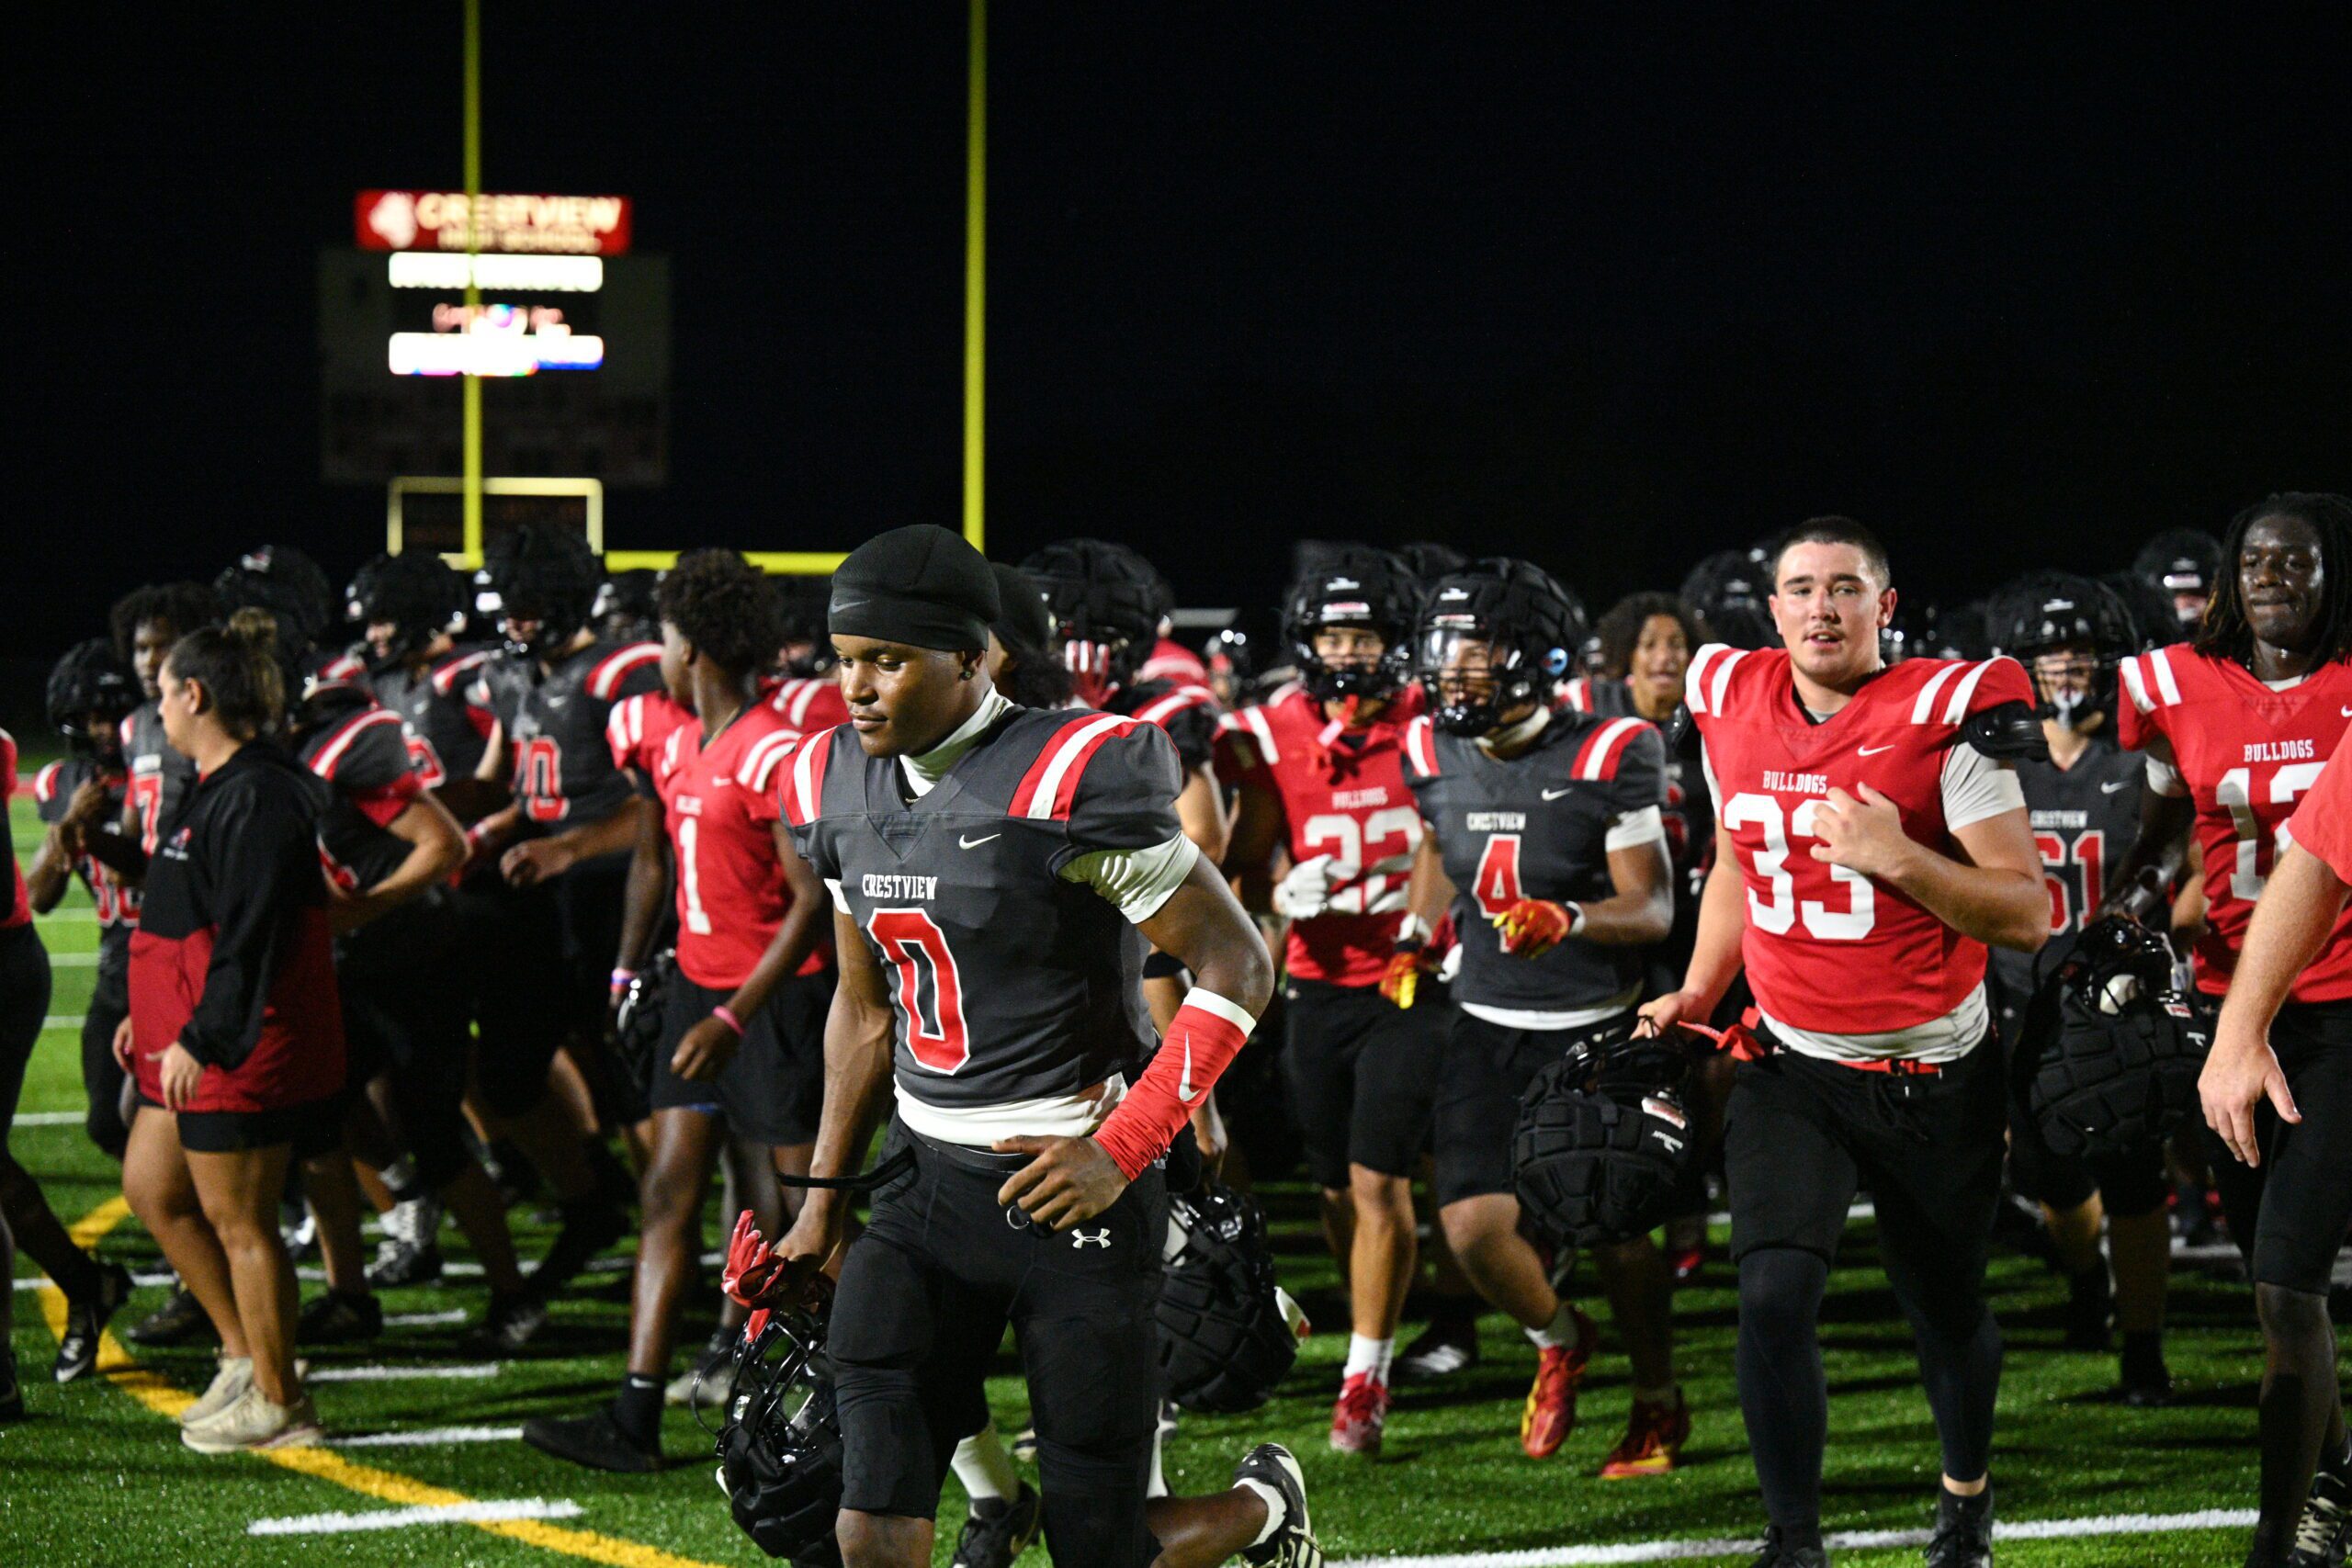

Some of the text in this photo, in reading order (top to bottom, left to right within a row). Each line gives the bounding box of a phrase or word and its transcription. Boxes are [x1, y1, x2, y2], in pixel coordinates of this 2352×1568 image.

[1762, 770, 1827, 795] BULLDOGS
[2244, 739, 2314, 762] BULLDOGS
[678, 816, 712, 935] 1
[862, 874, 938, 900] CRESTVIEW
[1472, 833, 1531, 953] 4
[1724, 792, 1875, 940] 33
[866, 908, 970, 1077] 0
